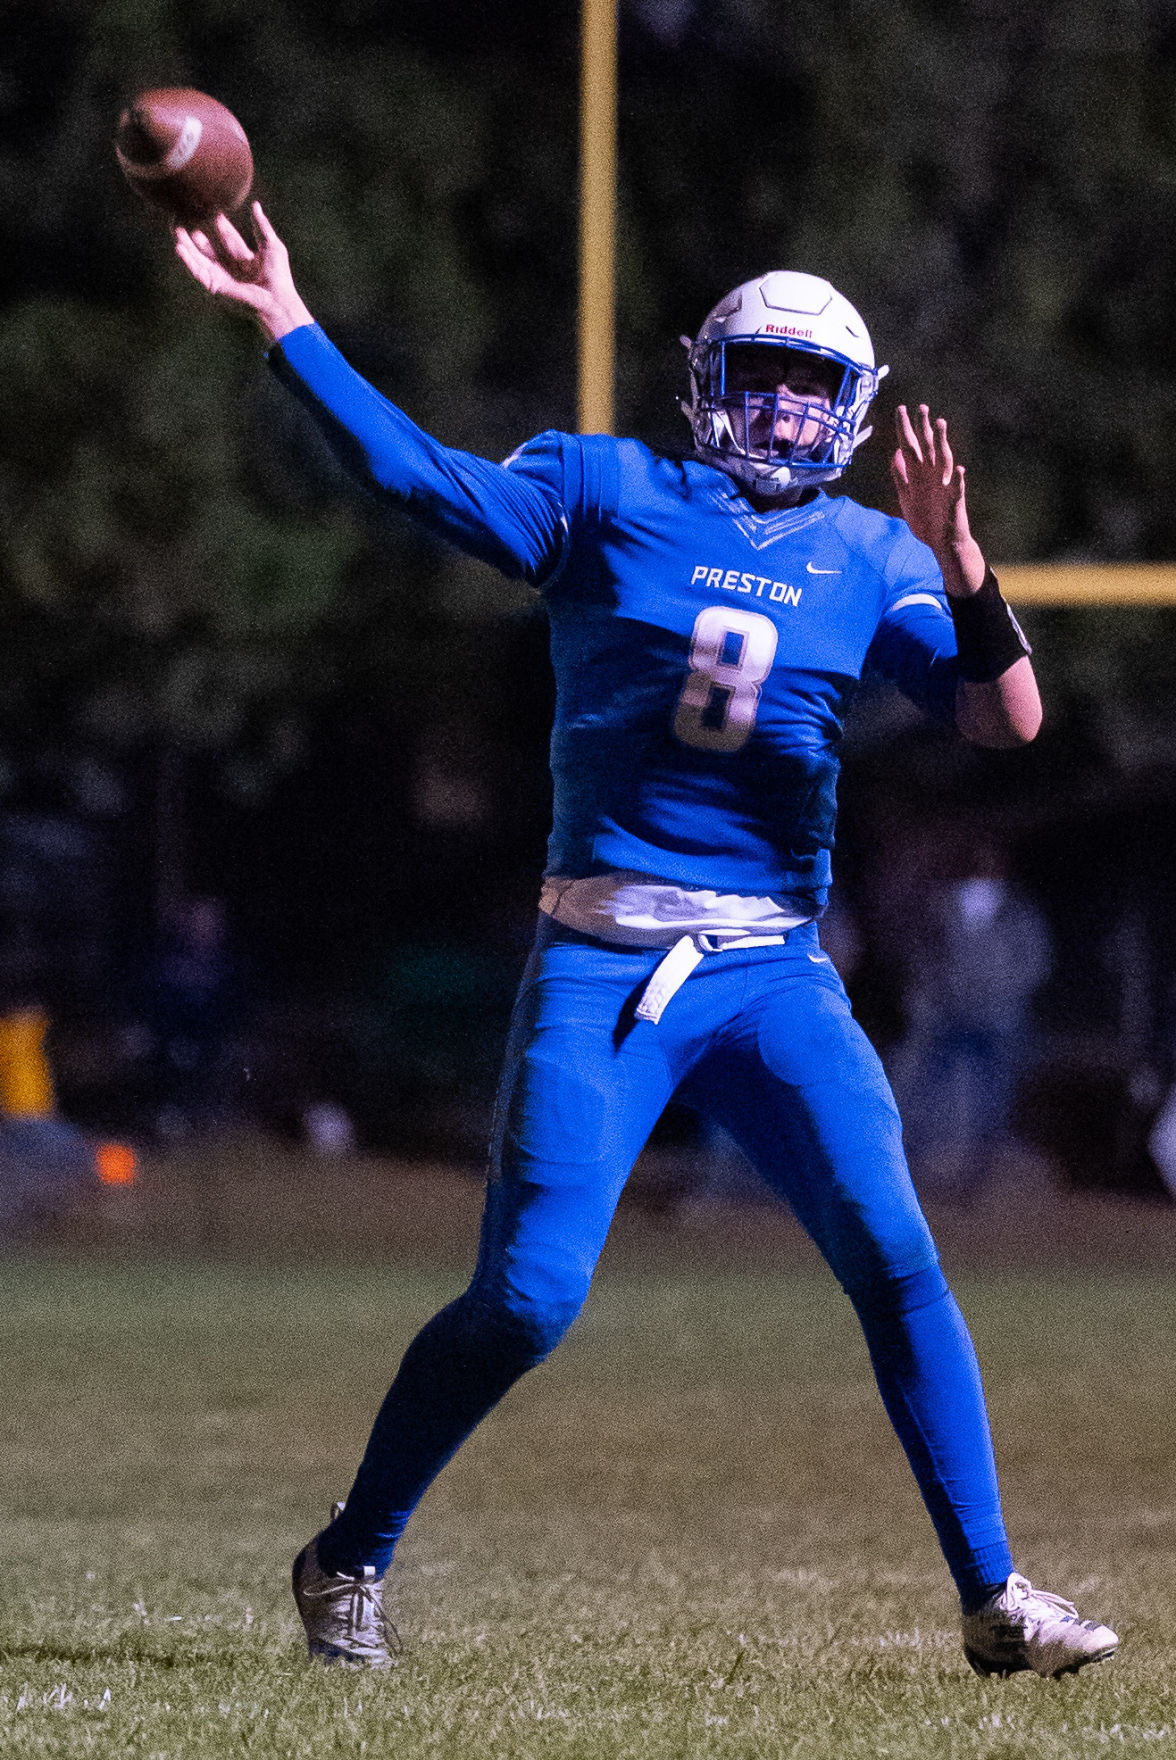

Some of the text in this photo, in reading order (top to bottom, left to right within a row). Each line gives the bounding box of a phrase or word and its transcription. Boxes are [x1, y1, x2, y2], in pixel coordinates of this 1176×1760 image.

[765, 324, 813, 339] Riddell
[690, 565, 803, 607] PRESTON
[674, 606, 779, 751] 8
